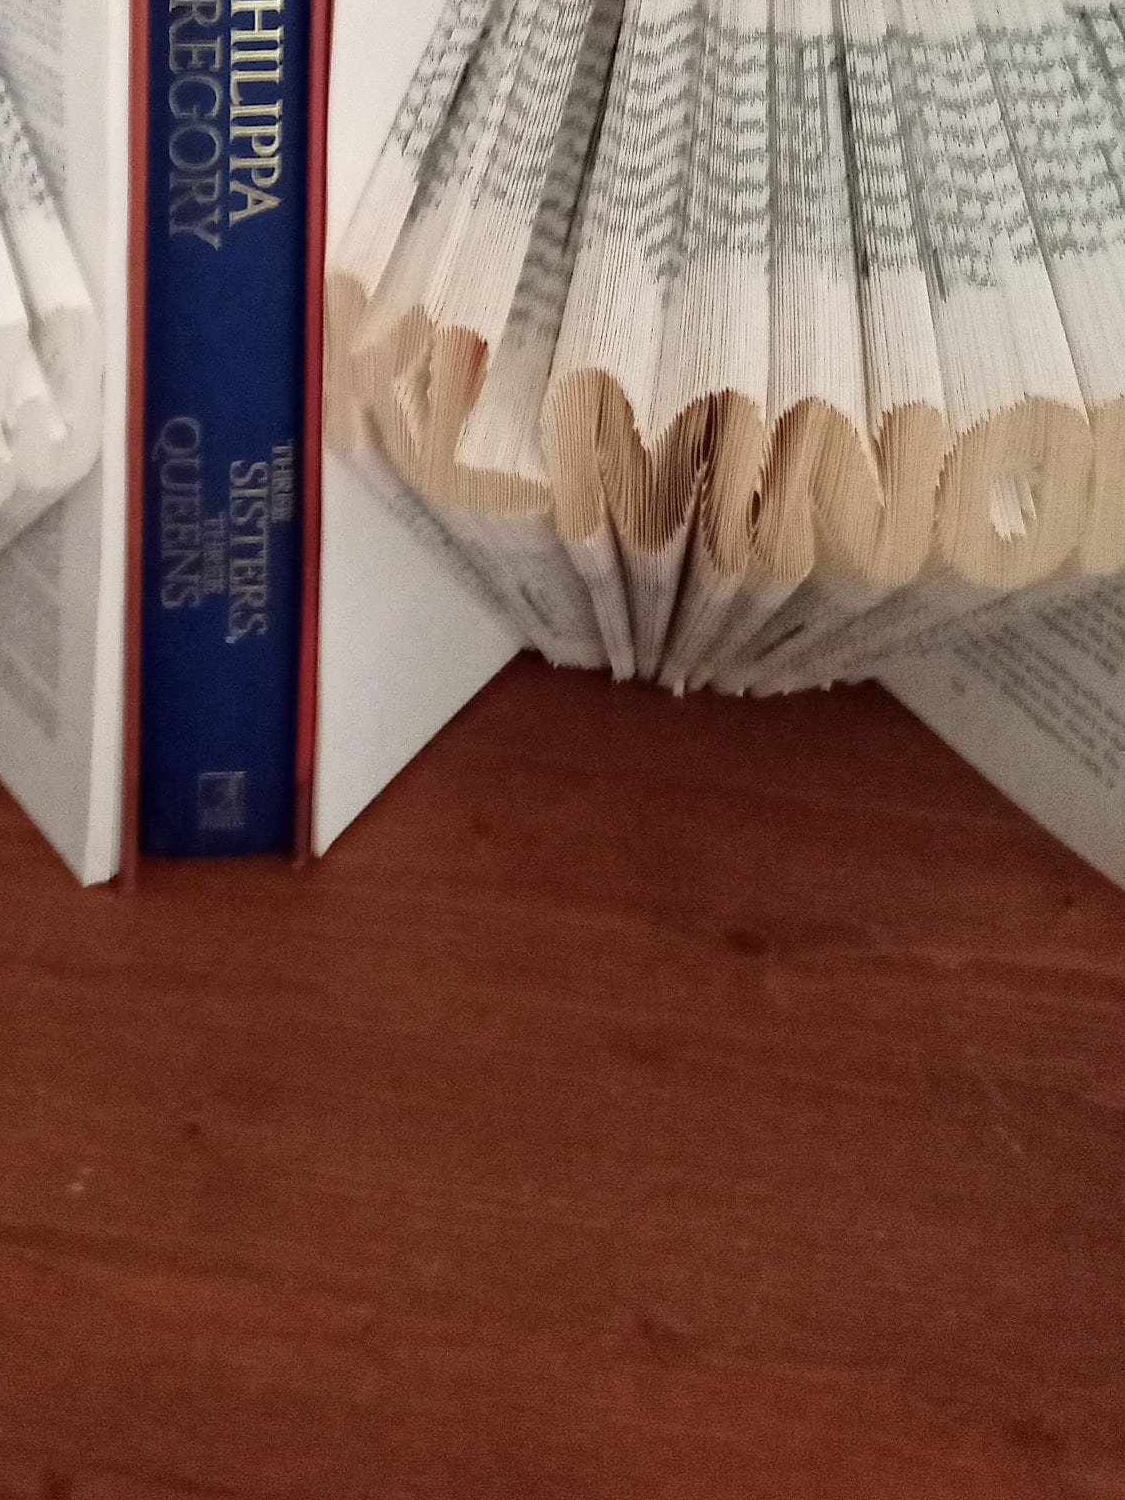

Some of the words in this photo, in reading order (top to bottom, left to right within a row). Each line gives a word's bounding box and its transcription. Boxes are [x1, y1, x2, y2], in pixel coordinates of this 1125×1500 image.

[151, 416, 202, 610] QUEENS
[225, 459, 269, 644] SISTERS,
[271, 438, 295, 524] THREE
